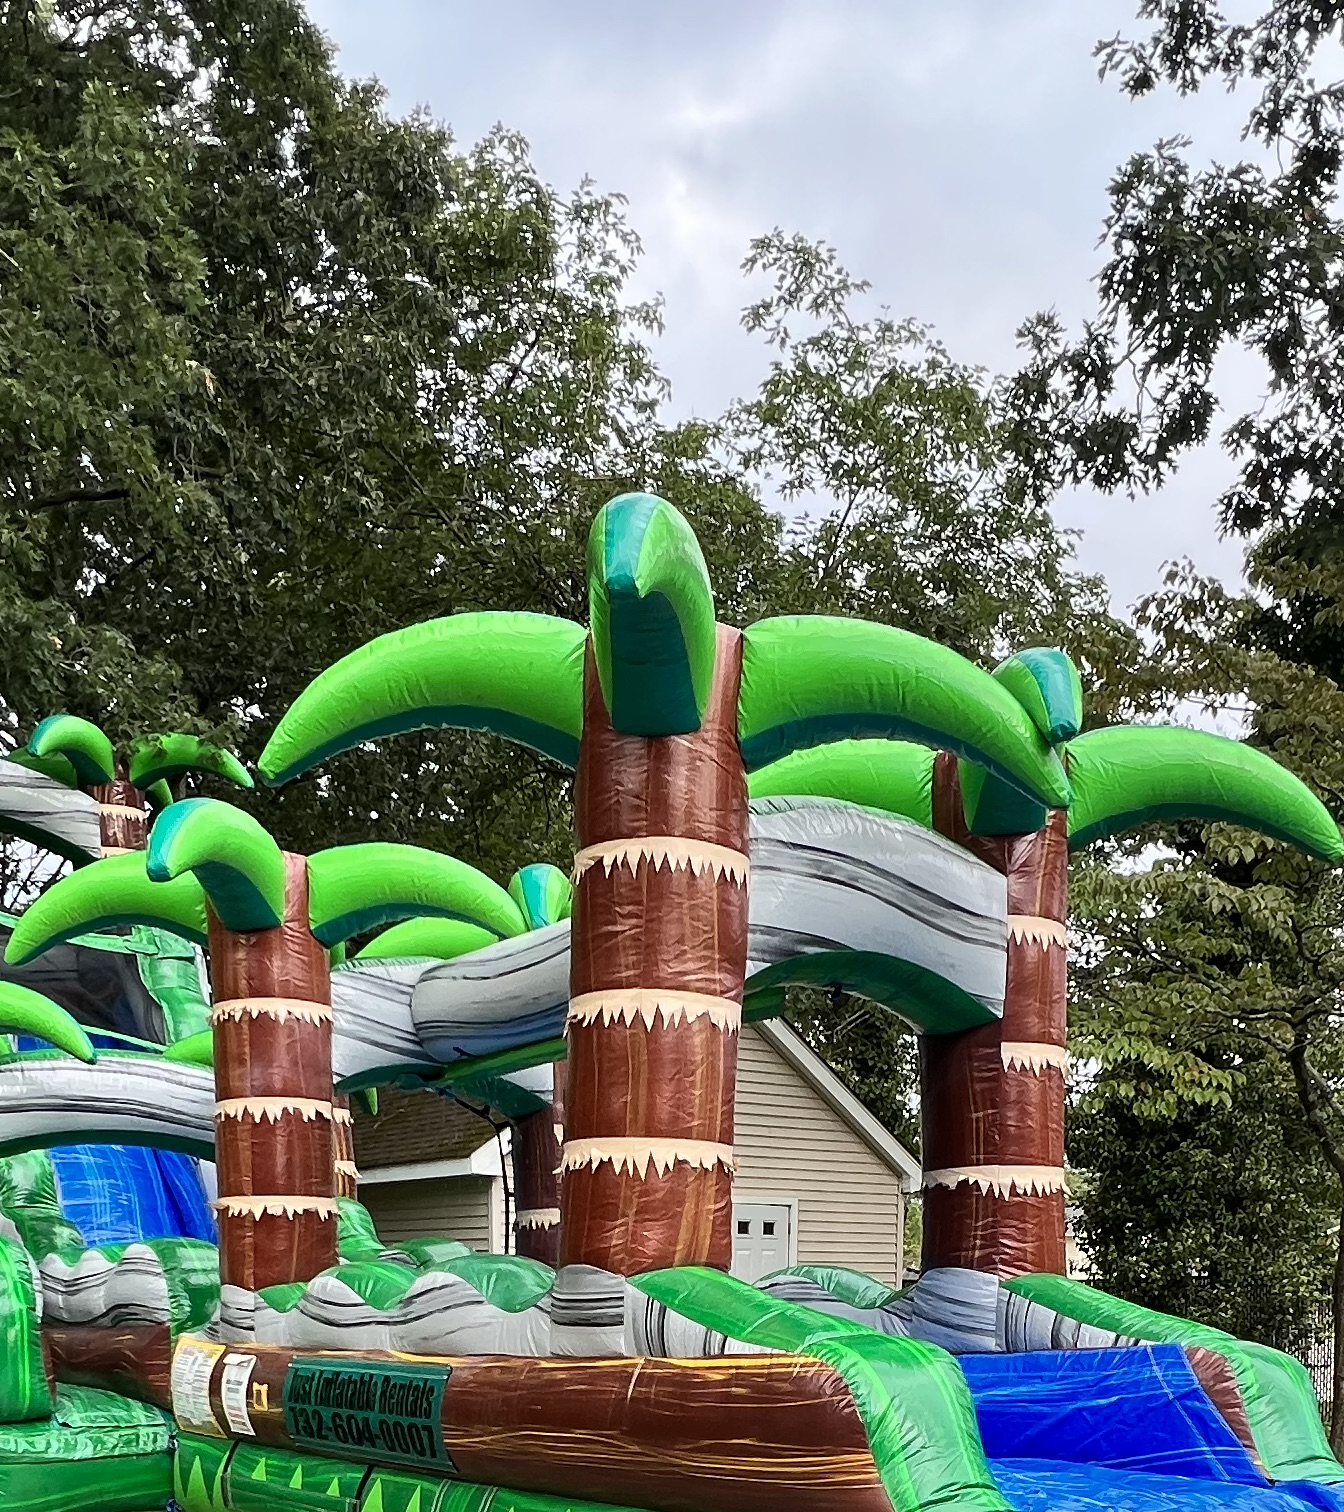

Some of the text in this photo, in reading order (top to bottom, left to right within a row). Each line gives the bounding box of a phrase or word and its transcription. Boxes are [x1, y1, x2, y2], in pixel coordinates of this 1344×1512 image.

[288, 1368, 316, 1405] Just
[314, 1369, 378, 1412] Inflatable
[379, 1375, 435, 1419] Rentals
[288, 1405, 437, 1459] 732-604-0007
